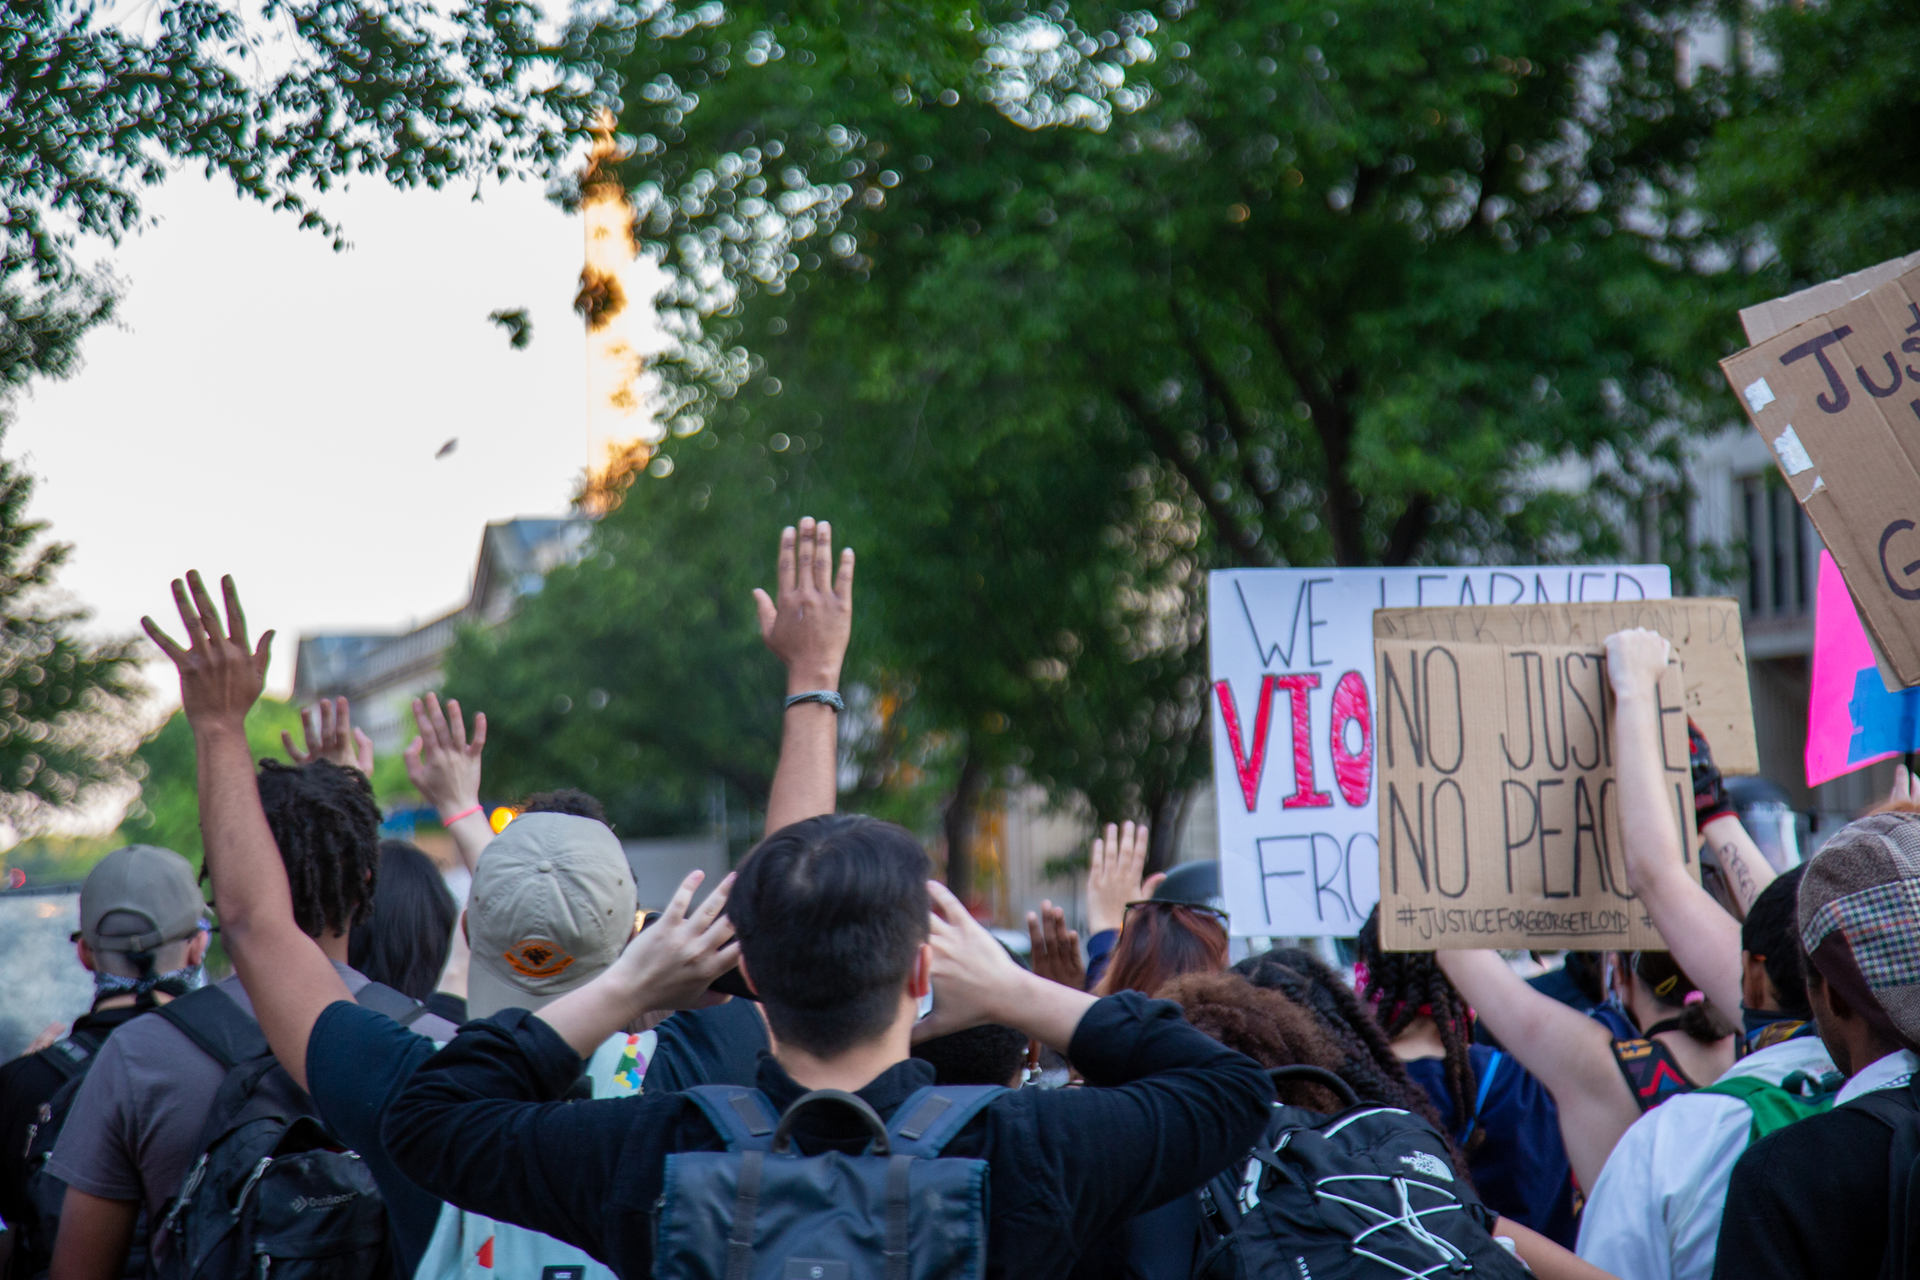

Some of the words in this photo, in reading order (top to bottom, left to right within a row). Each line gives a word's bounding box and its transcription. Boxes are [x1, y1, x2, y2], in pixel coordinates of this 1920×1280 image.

[1233, 576, 1334, 668] WE
[1383, 645, 1465, 775] NO
[1500, 651, 1688, 773] JUSTE
[1389, 777, 1470, 899] NO
